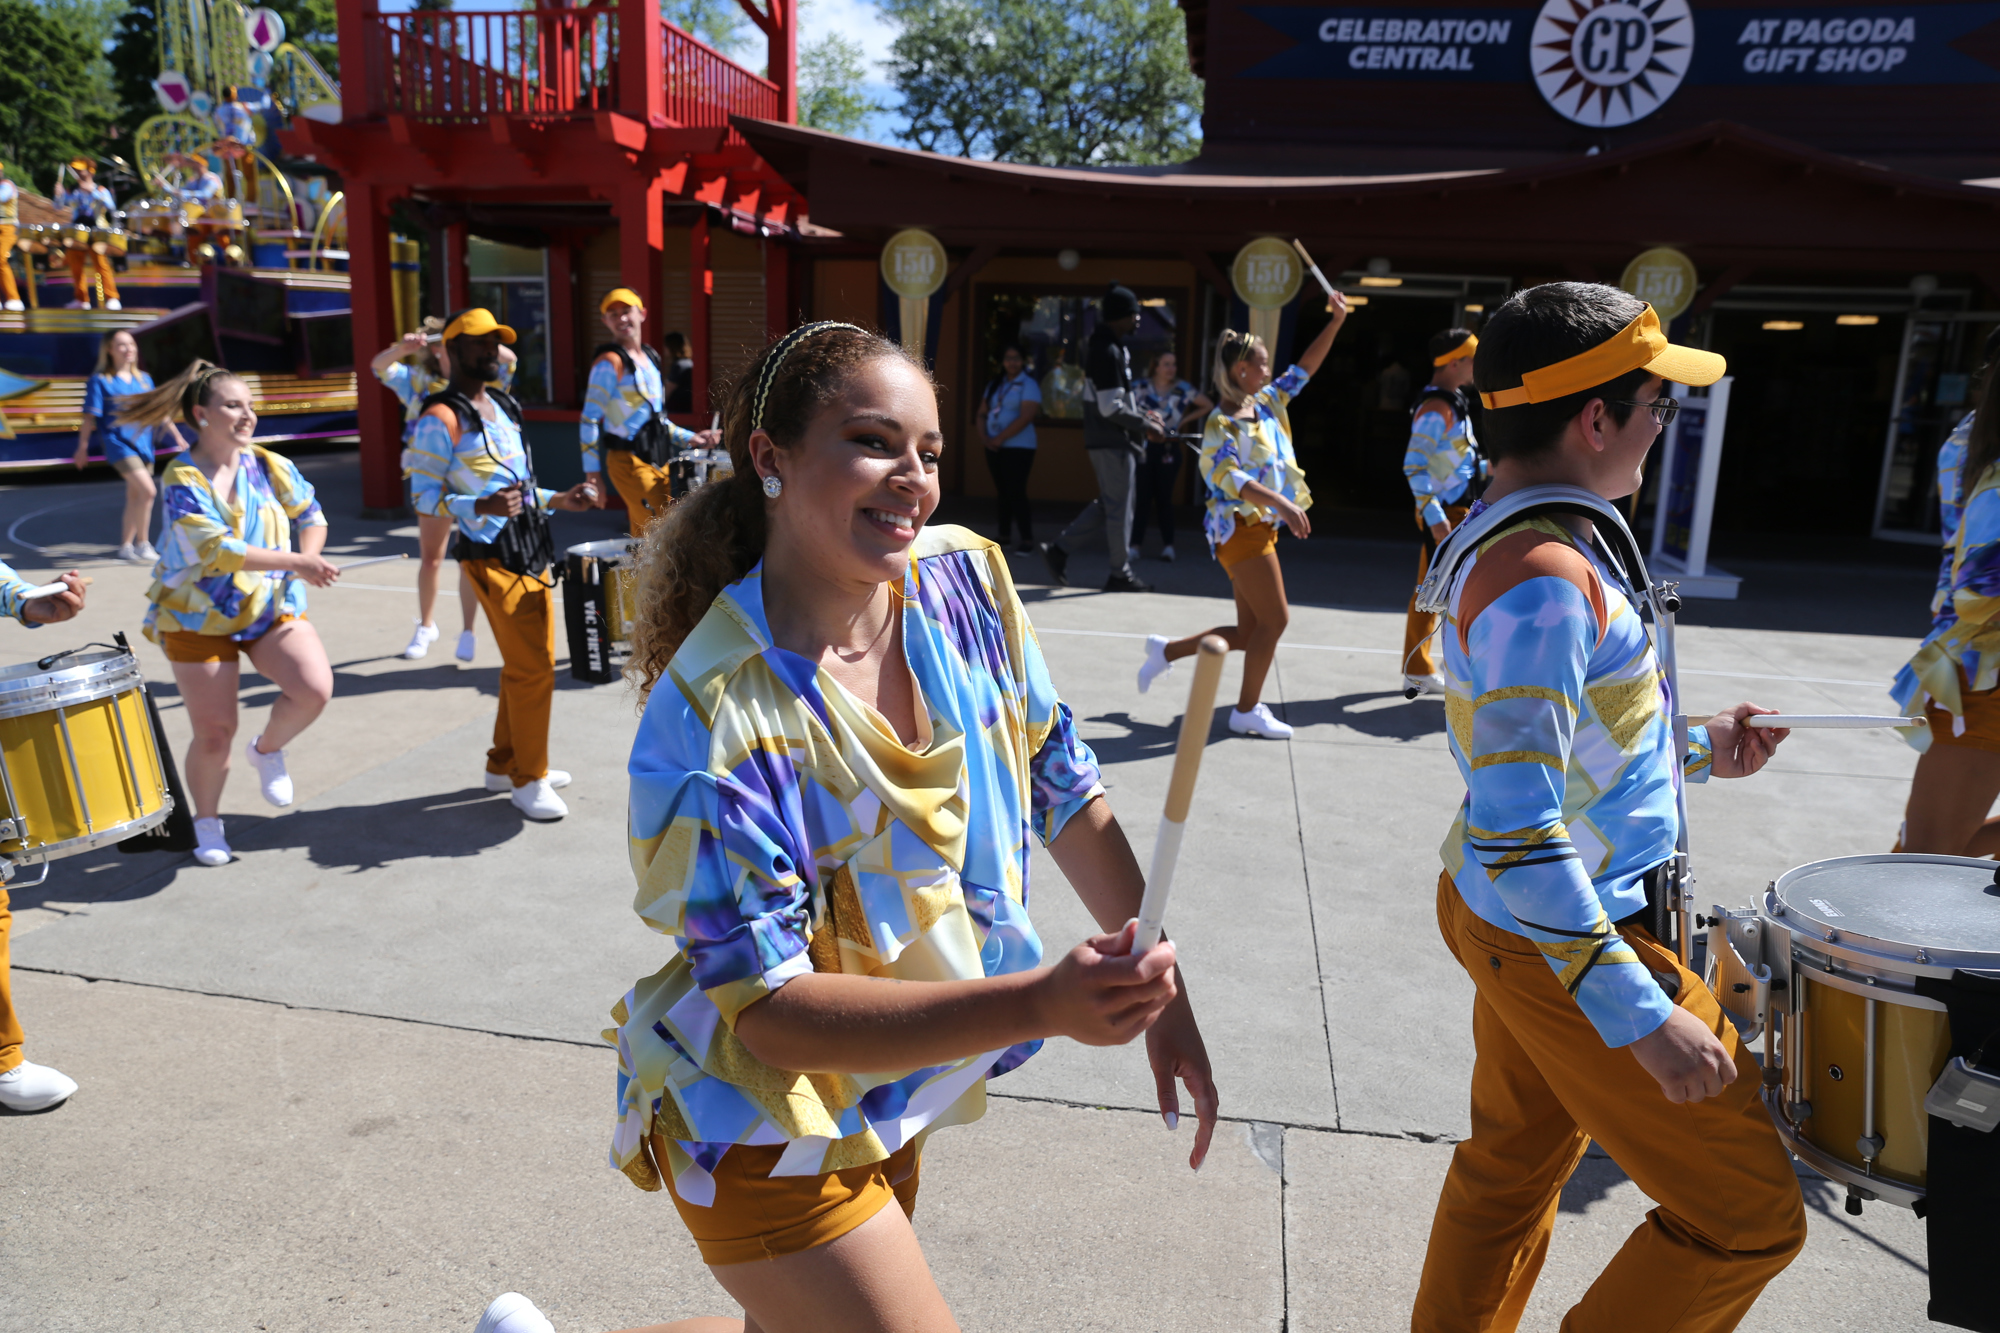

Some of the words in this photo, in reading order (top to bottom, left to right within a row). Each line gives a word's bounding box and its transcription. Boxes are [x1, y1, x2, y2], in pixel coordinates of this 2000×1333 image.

[1318, 18, 1511, 44] CELEBRATION
[1737, 19, 1781, 45] AT
[1780, 17, 1915, 44] PAGODA
[1348, 45, 1474, 70] CENTRAL
[1581, 17, 1646, 74] CP
[1742, 47, 1816, 73] GIFT
[1814, 46, 1907, 72] SHOP
[894, 252, 936, 276] 150
[1246, 261, 1290, 286] 150
[1635, 272, 1683, 298] 150
[584, 600, 600, 625] VIC
[586, 628, 603, 672] FIRTH
[1808, 899, 1839, 917] EVANS
